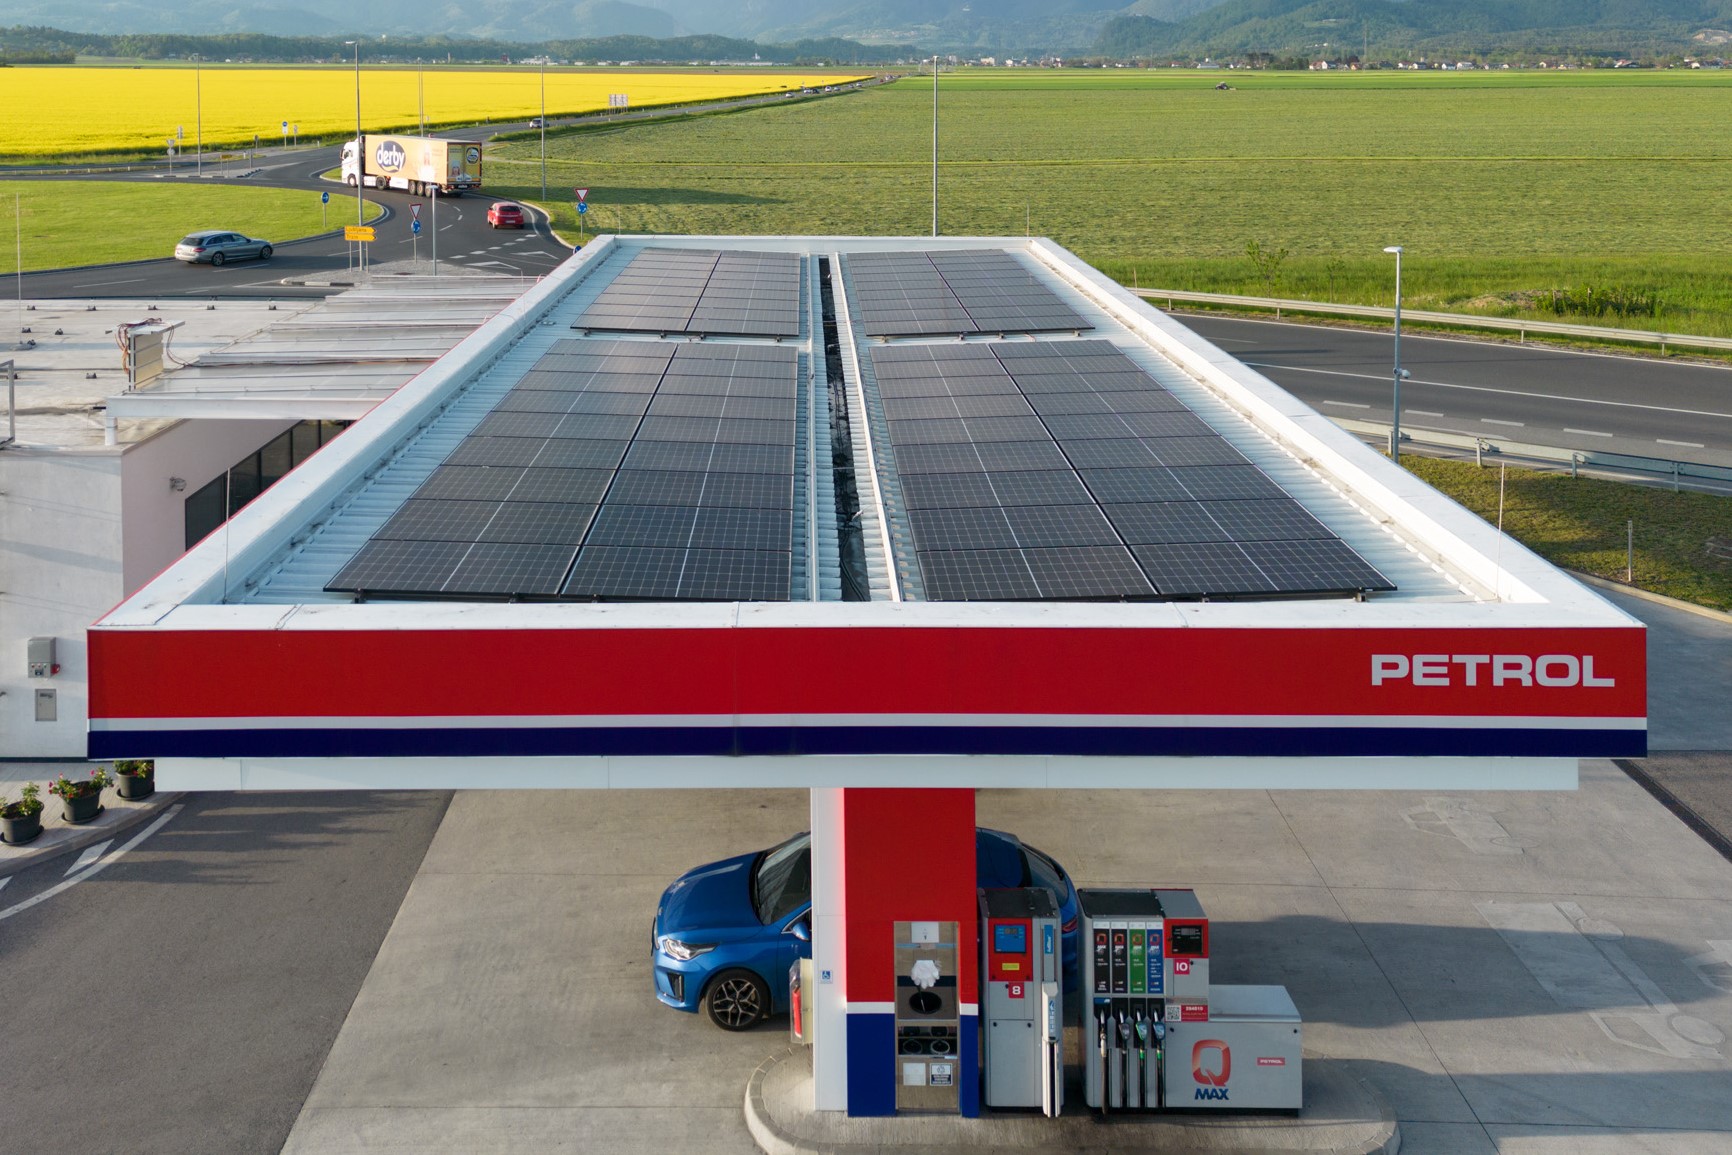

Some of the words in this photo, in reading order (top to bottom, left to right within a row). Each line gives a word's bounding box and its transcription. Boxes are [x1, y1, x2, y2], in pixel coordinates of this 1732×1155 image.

[377, 141, 405, 171] derby
[1371, 654, 1615, 687] PETROL
[1176, 962, 1188, 972] 10
[1012, 985, 1021, 995] 8
[1192, 1039, 1231, 1087] Q
[1195, 1088, 1230, 1100] MAX
